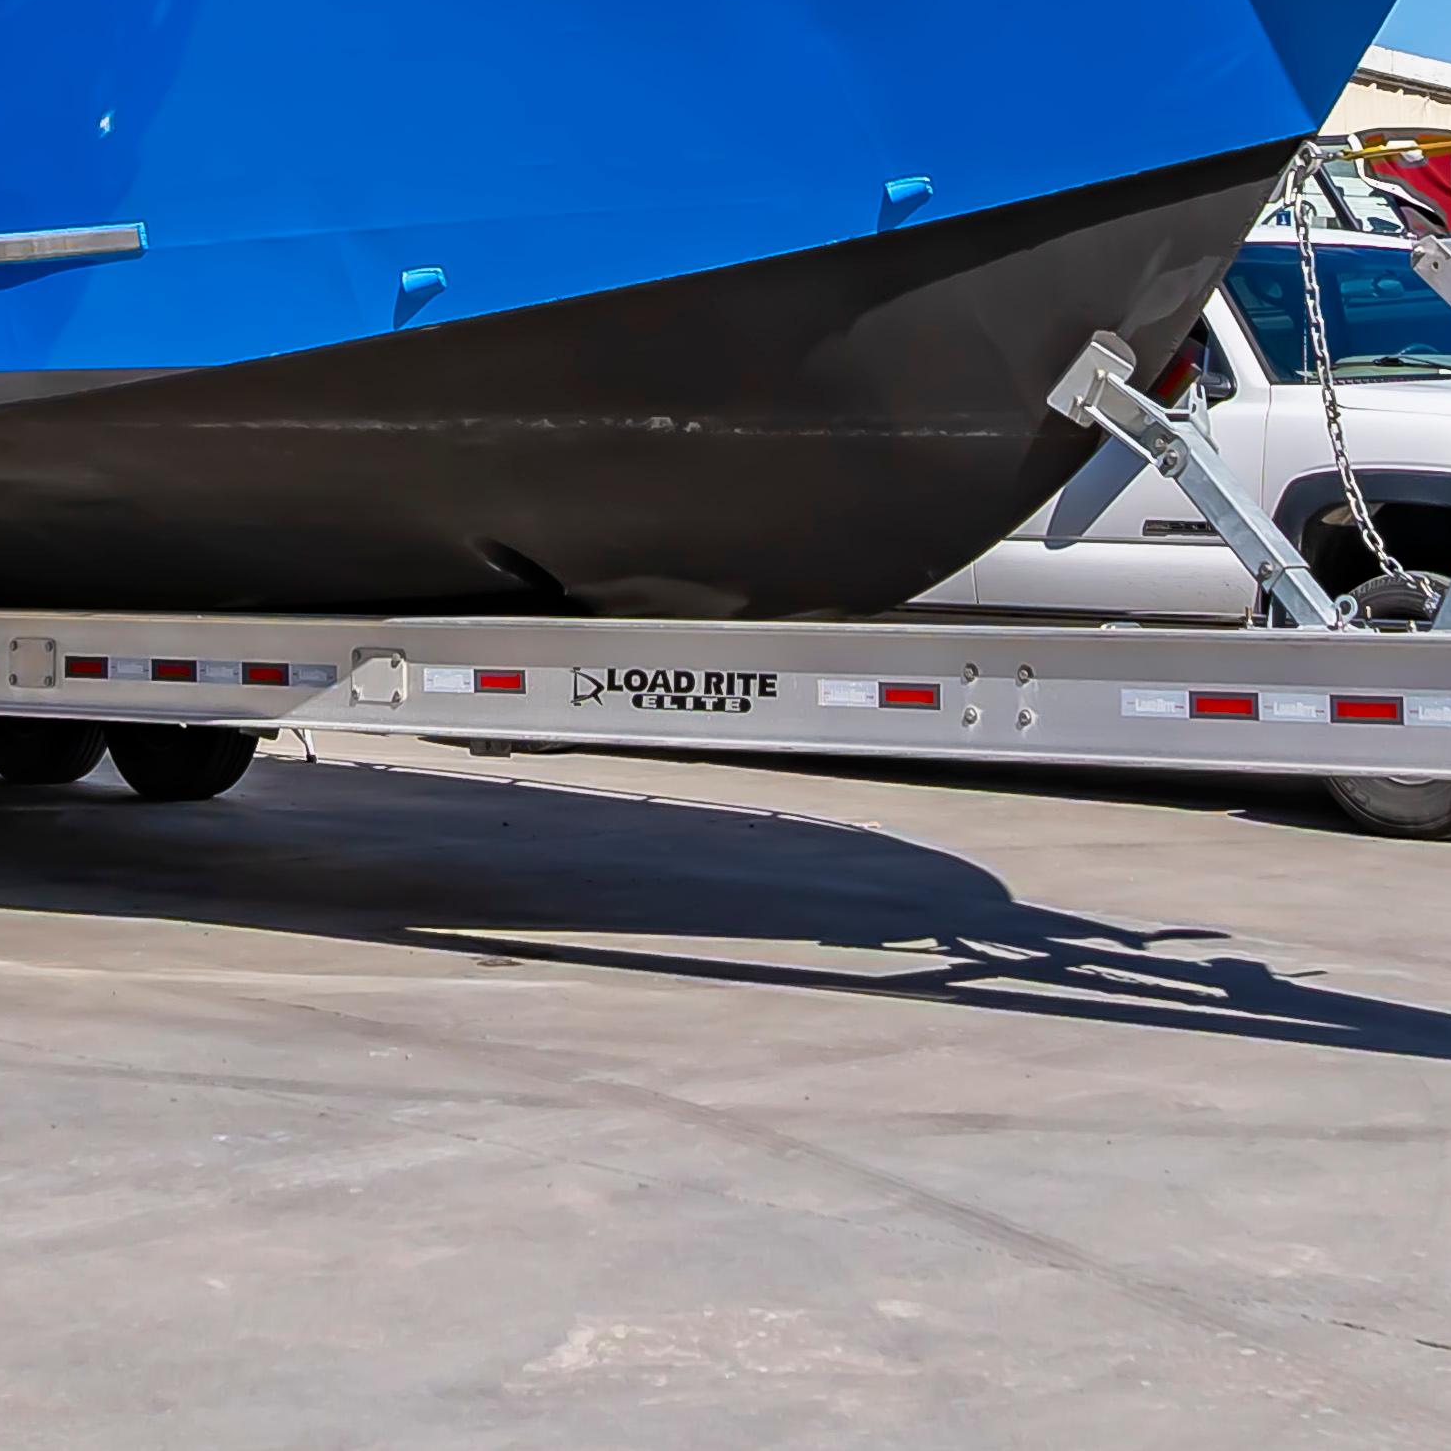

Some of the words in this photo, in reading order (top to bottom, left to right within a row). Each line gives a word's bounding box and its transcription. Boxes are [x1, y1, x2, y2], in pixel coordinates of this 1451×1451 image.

[607, 668, 695, 693] LOAD
[704, 672, 777, 697] RITE
[642, 696, 742, 712] ELITE
